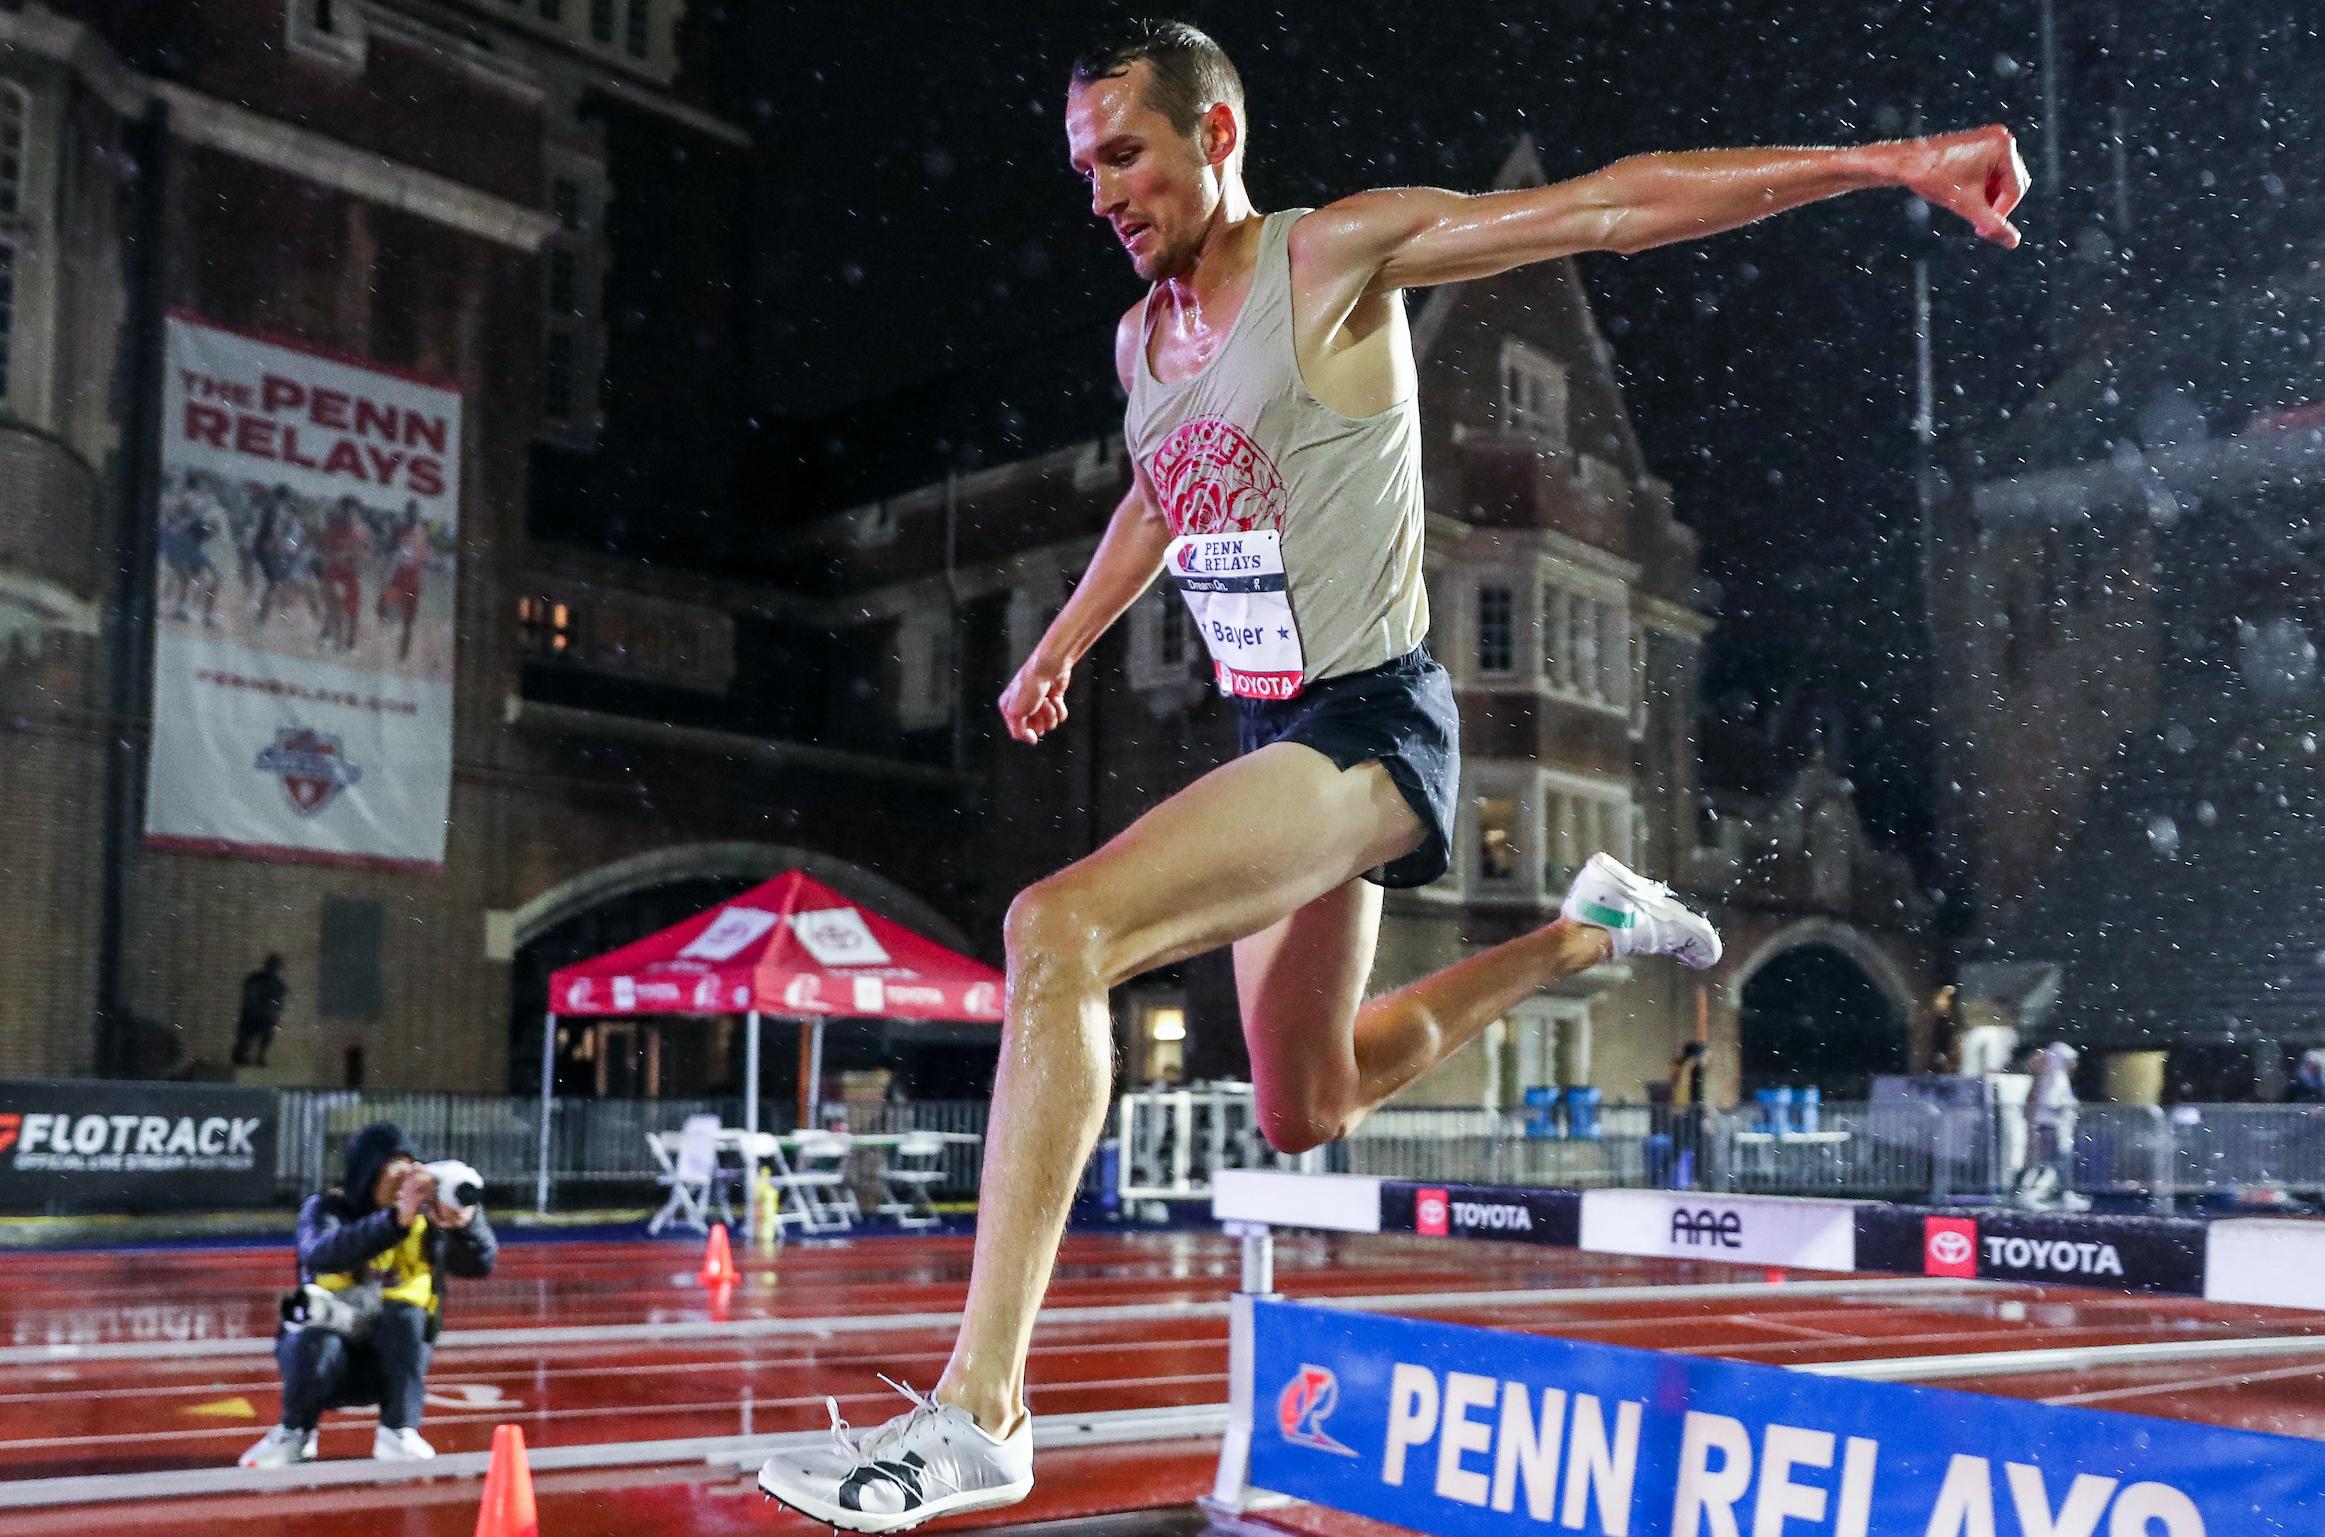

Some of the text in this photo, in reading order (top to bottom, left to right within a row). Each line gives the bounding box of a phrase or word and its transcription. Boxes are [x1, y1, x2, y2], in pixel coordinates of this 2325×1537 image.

[262, 373, 447, 454] PENN
[184, 402, 445, 496] RELAYS
[1204, 540, 1243, 555] PENN
[1204, 555, 1261, 571] RELAYS
[1212, 620, 1264, 649] Bayer
[18, 1112, 262, 1155] FLOTRACK
[1451, 1201, 1533, 1231] TOYOTA
[1984, 1235, 2125, 1276] TOYOTA
[1381, 1361, 1643, 1537] PENN
